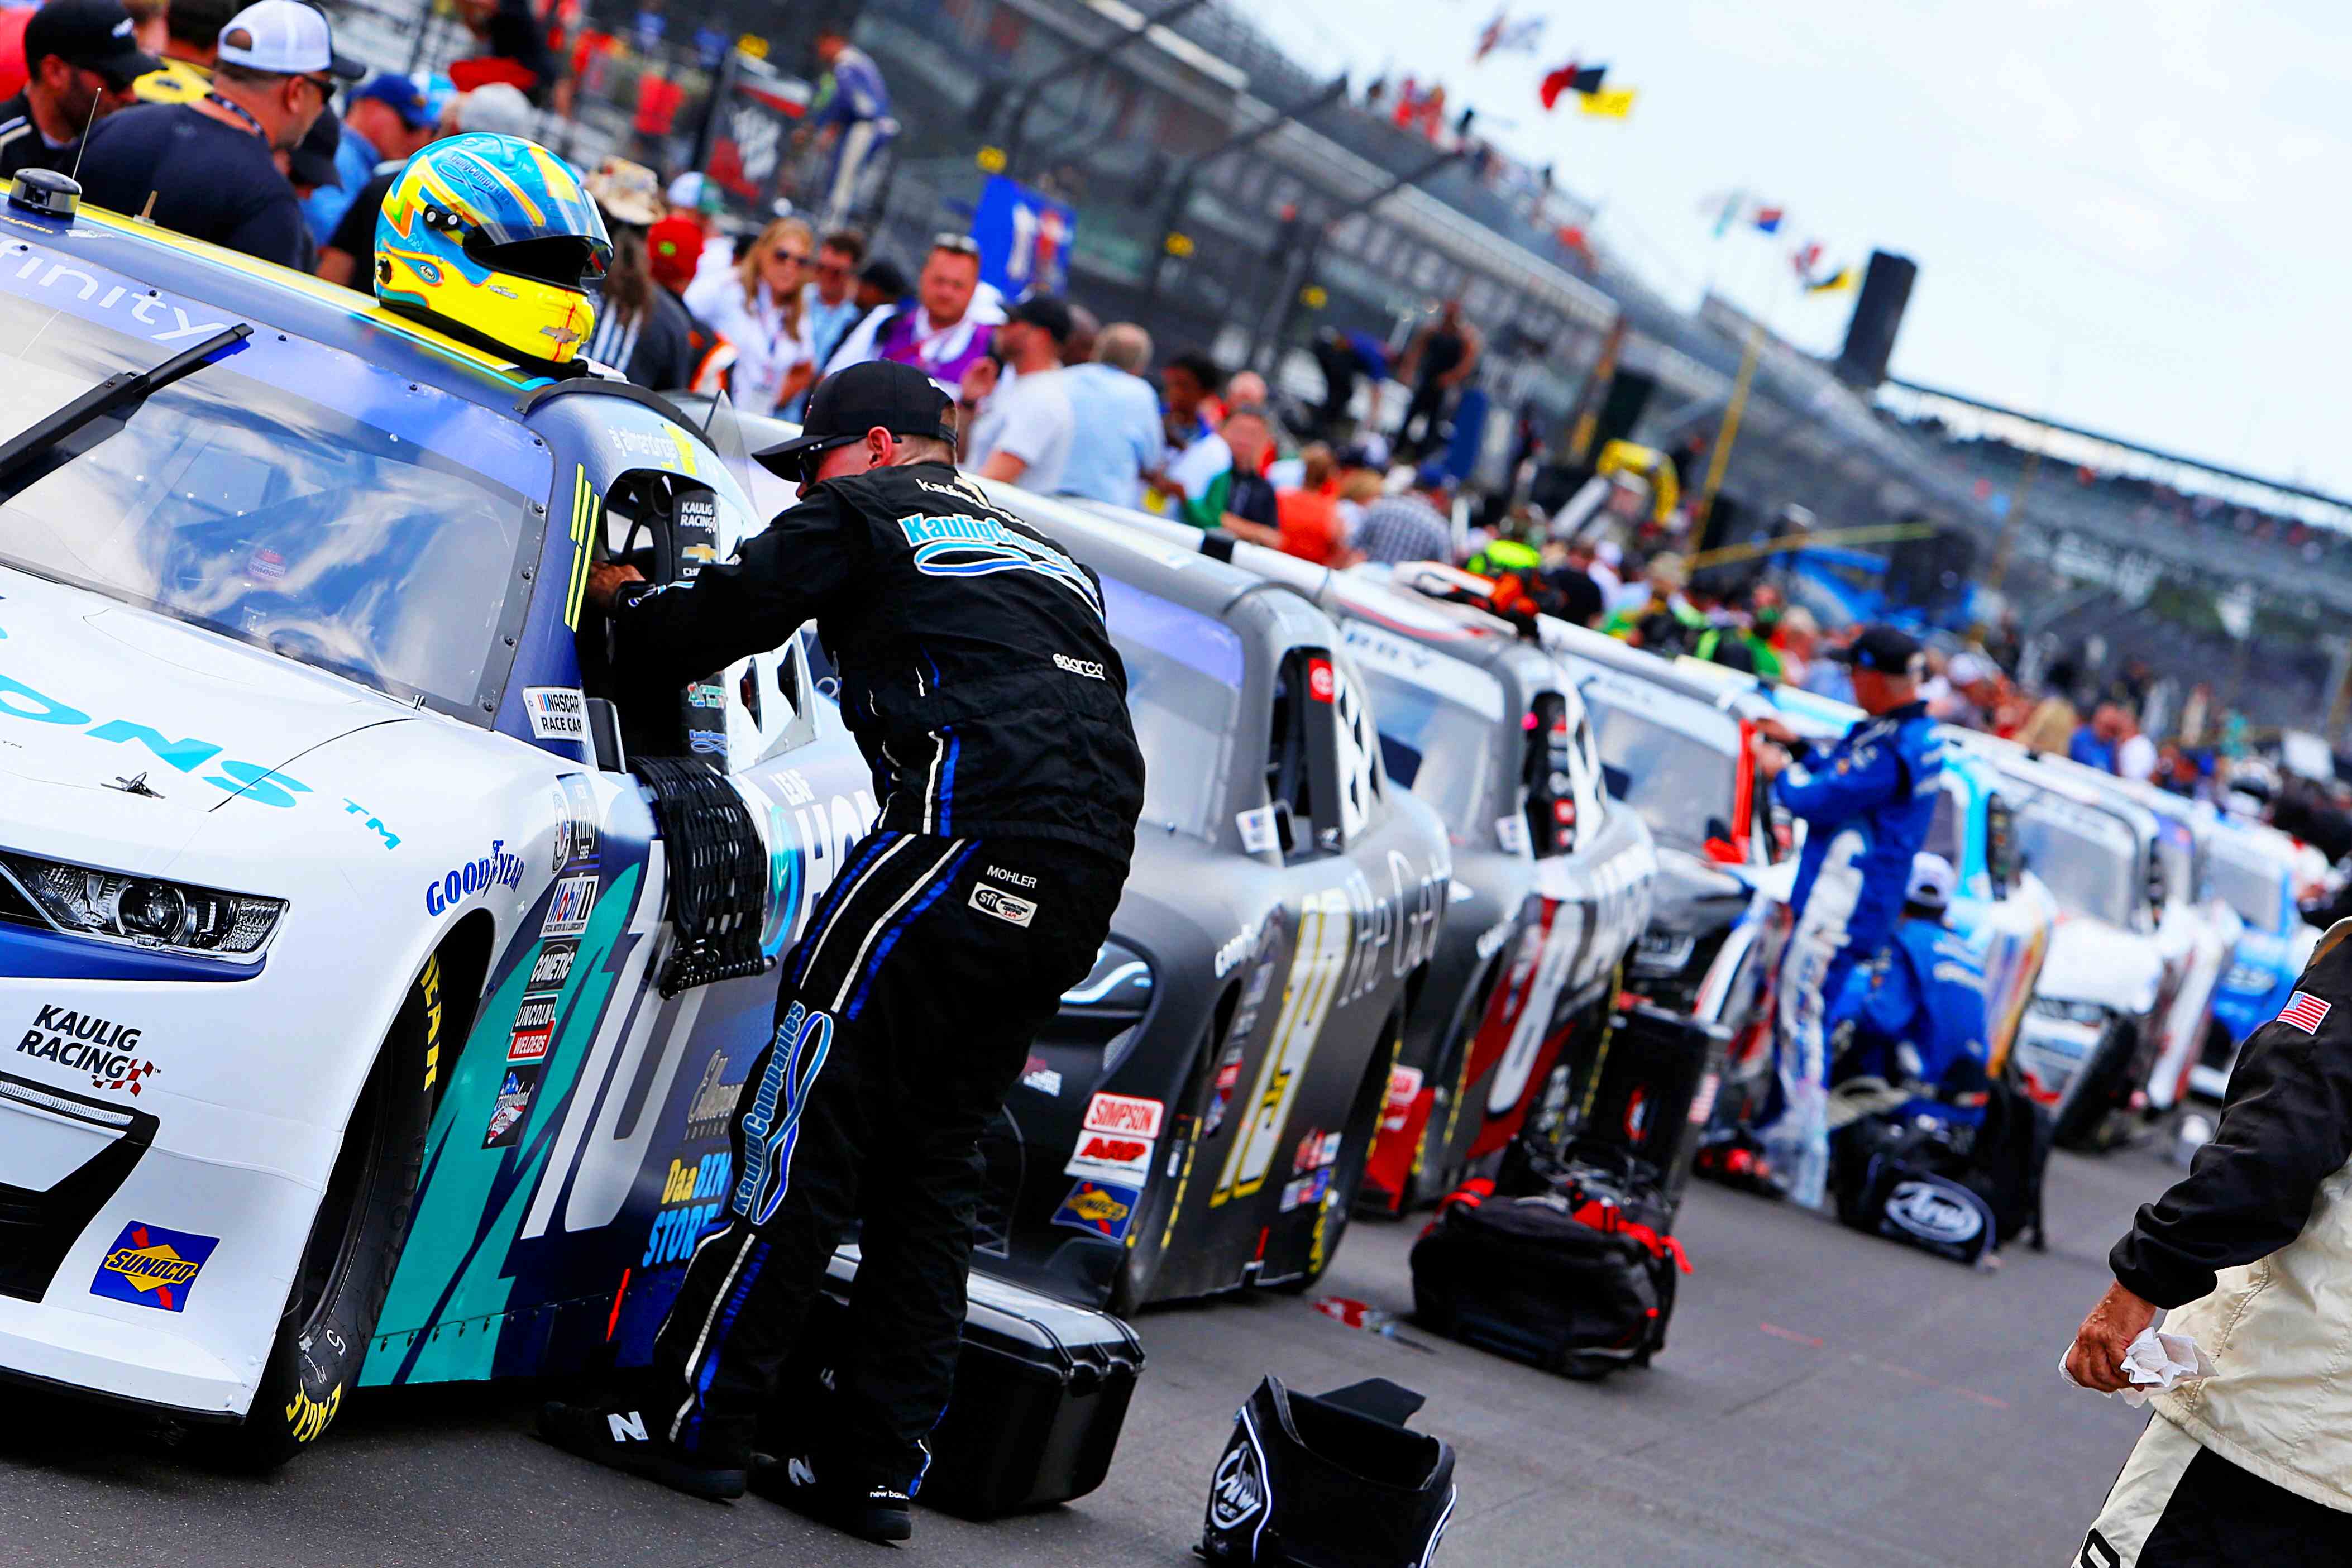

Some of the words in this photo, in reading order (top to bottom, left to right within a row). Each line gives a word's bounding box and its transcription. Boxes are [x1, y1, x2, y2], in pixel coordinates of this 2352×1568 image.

[680, 514, 713, 528] RACING
[681, 501, 713, 515] KAULIG
[1053, 653, 1105, 678] sparco
[546, 694, 580, 713] NASCAR
[541, 717, 566, 731] RACE
[567, 718, 582, 733] CAR
[769, 768, 815, 806] LEAF
[342, 797, 401, 850] TM
[986, 864, 1038, 890] MOHLER
[547, 881, 584, 923] Mobil
[579, 882, 593, 919] 1
[979, 892, 998, 907] sfi
[531, 952, 575, 982] COMETIC
[32, 1003, 142, 1052] KAULIG
[515, 1004, 553, 1027] LINCOLN
[16, 1030, 130, 1079] RACING
[513, 1035, 547, 1055] WELDERS
[732, 1000, 806, 1216] KauligCompanies
[1092, 1099, 1155, 1132] SIMPSON
[1080, 1137, 1146, 1162] ARP
[661, 1151, 732, 1204] DaaBIN
[108, 1250, 195, 1283] SUNOCO
[607, 1411, 649, 1442] N
